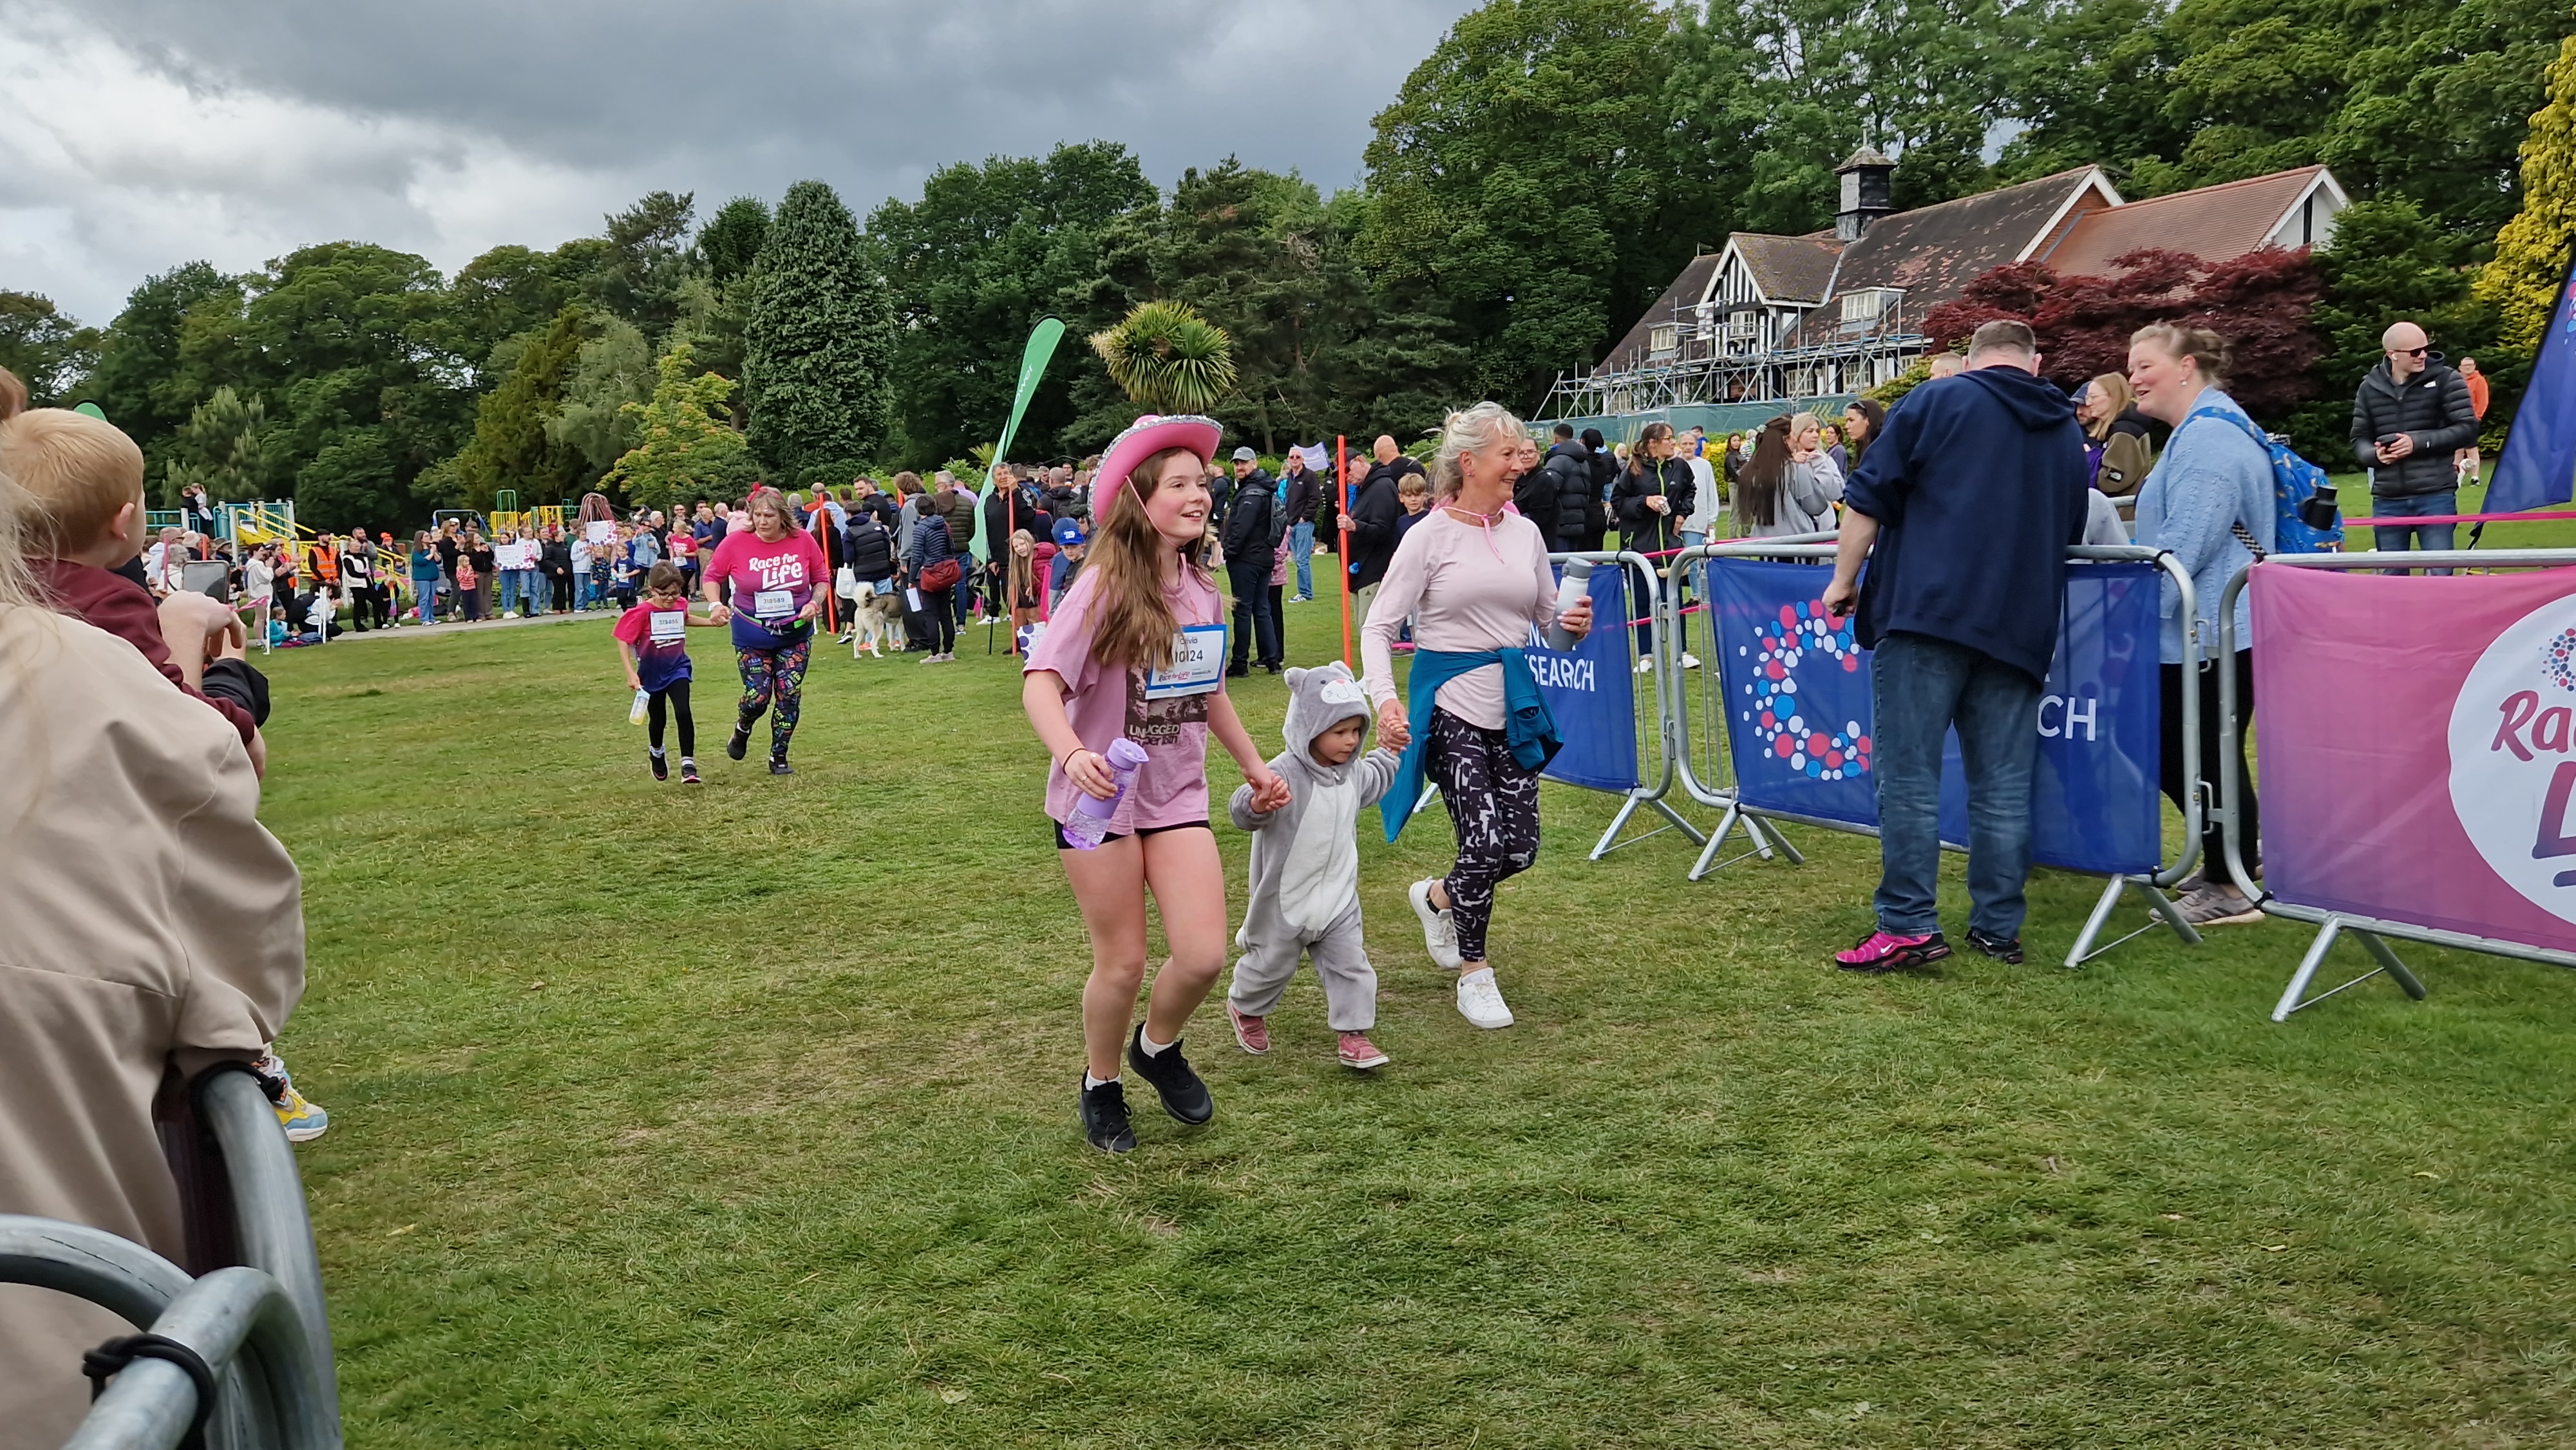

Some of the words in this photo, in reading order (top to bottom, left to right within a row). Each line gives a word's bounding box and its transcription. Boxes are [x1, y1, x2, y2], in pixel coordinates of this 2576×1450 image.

[749, 556, 781, 571] Race
[782, 553, 799, 564] for
[762, 562, 803, 590] Life
[1524, 654, 1595, 692] SEARCH
[2490, 690, 2576, 762] Ra
